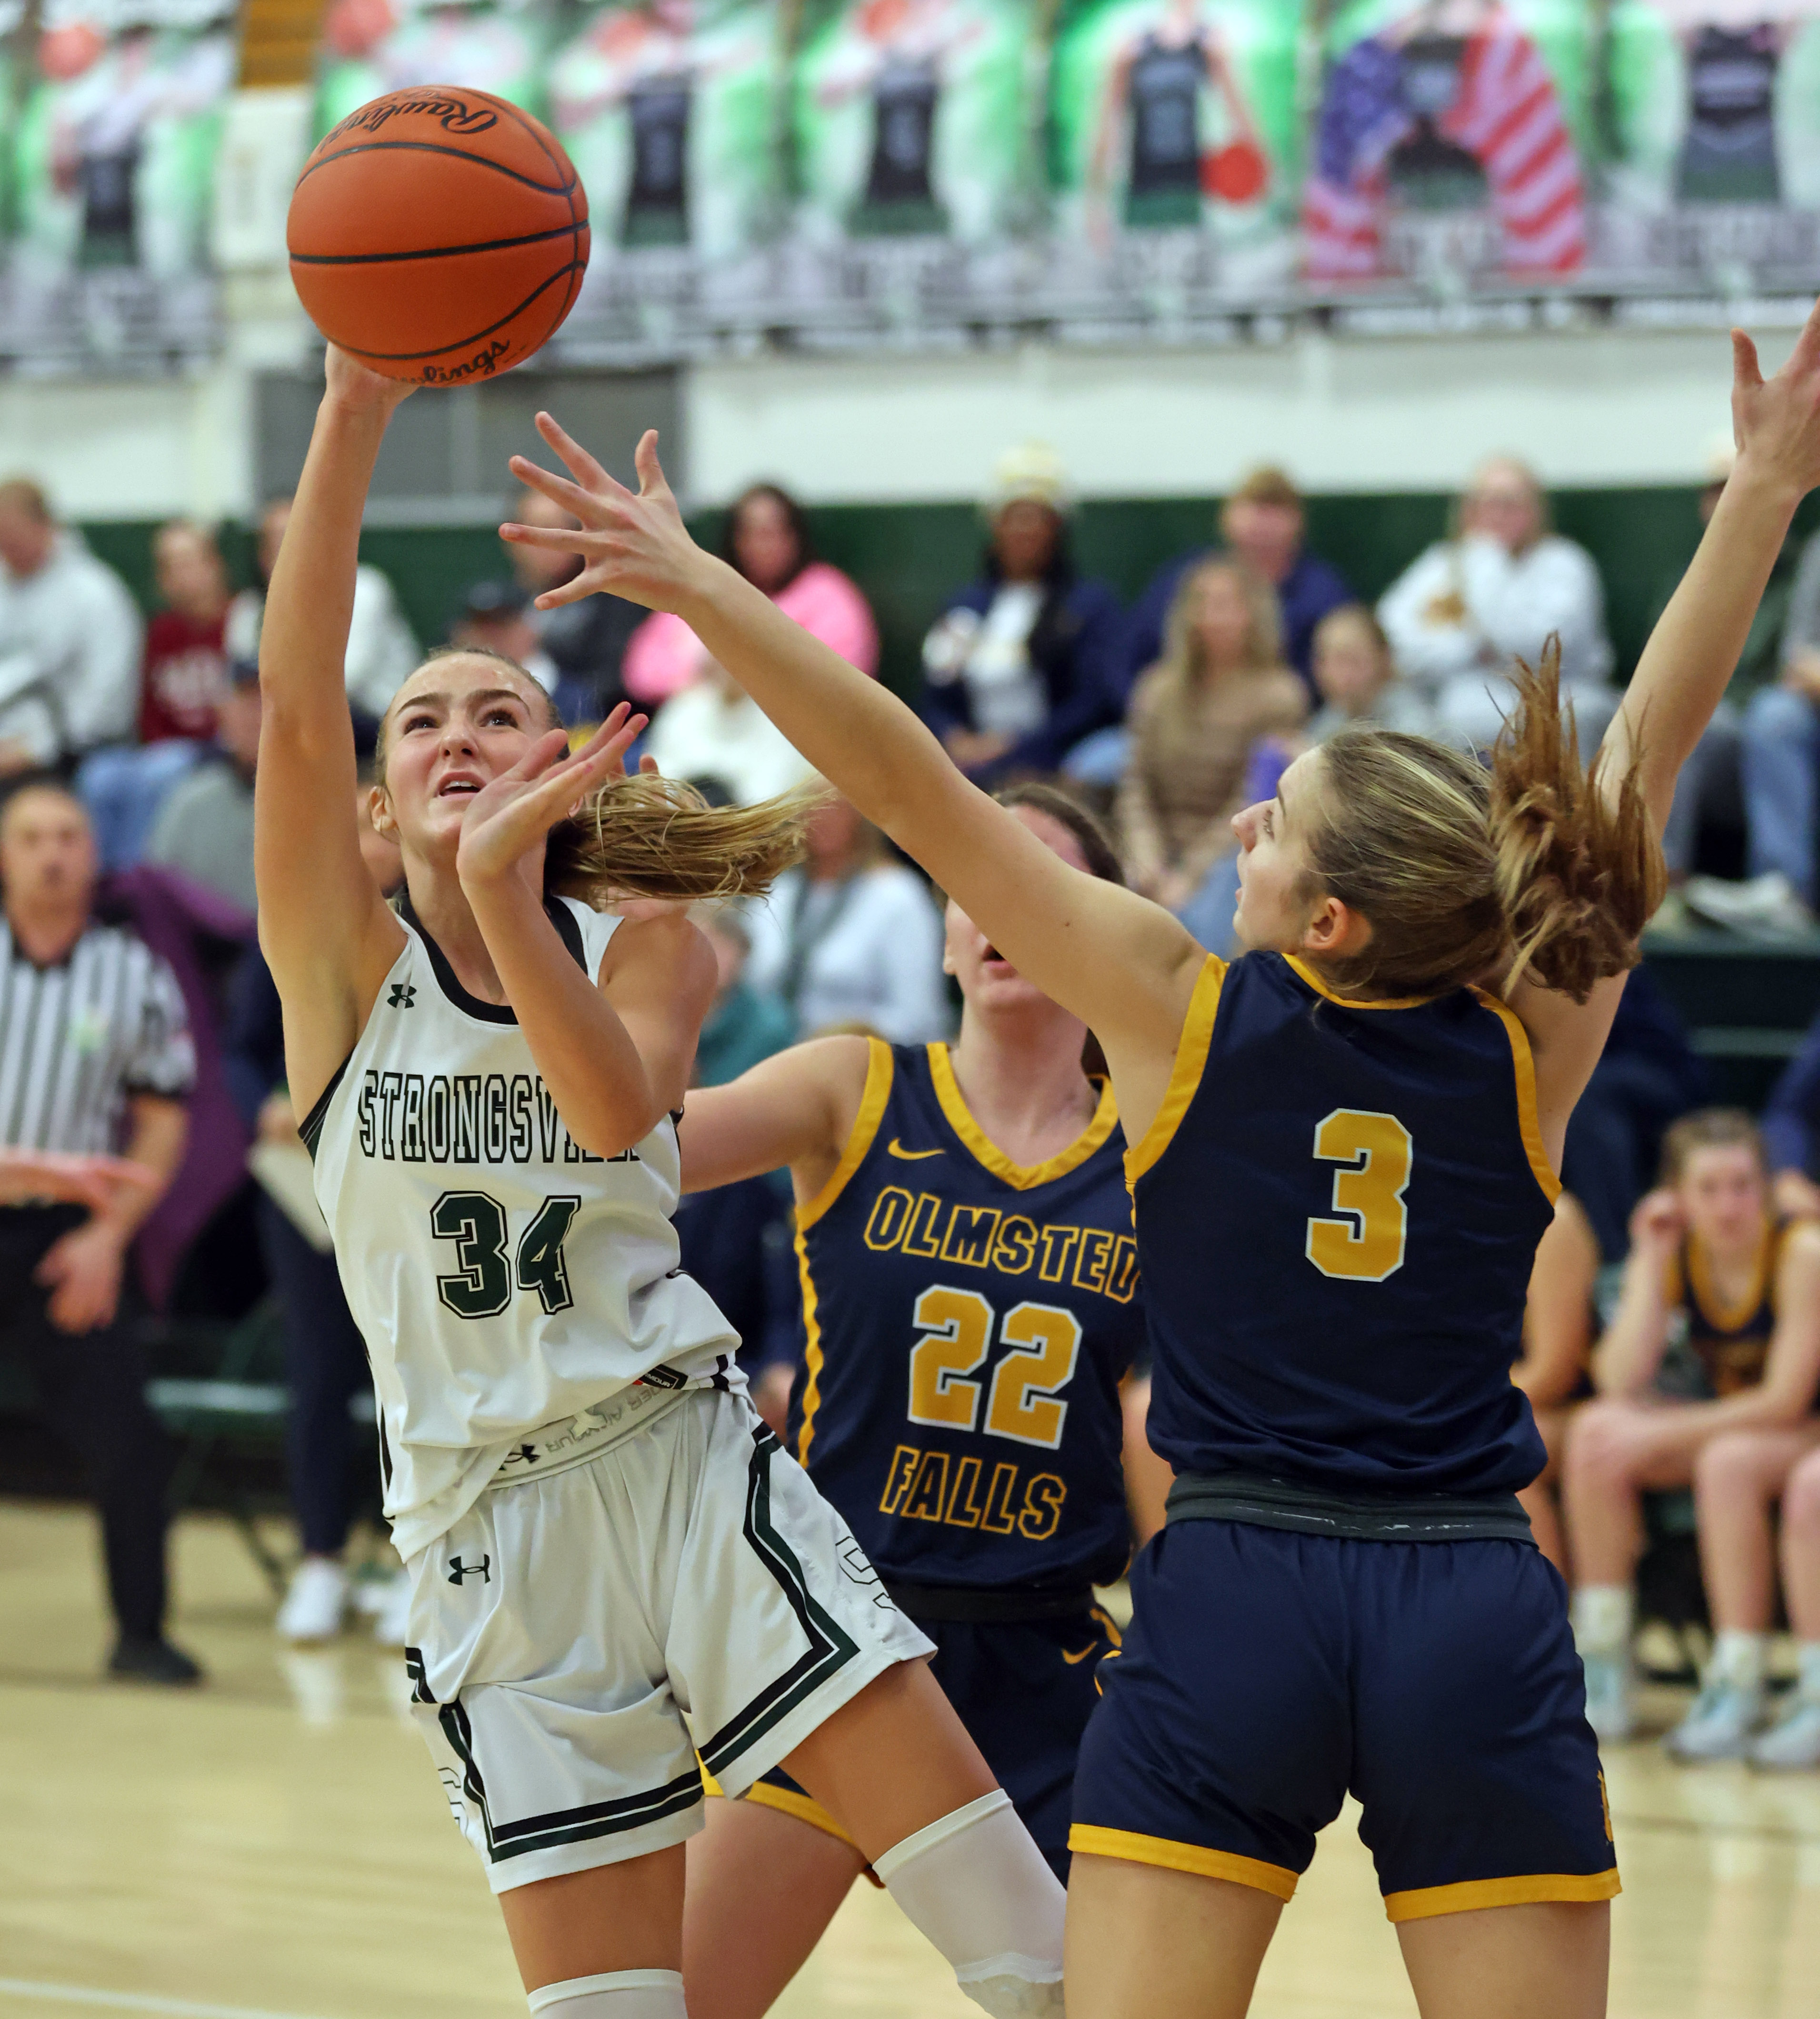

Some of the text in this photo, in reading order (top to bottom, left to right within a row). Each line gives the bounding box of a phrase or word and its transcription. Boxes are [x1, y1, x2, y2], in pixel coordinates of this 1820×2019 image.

[358, 1069, 640, 1163] STRONGSV
[430, 1191, 581, 1319] 34
[863, 1185, 1141, 1304] OLMSTED
[1305, 1108, 1413, 1282] 3
[907, 1284, 1083, 1450] 22
[879, 1444, 1067, 1540] FALLS
